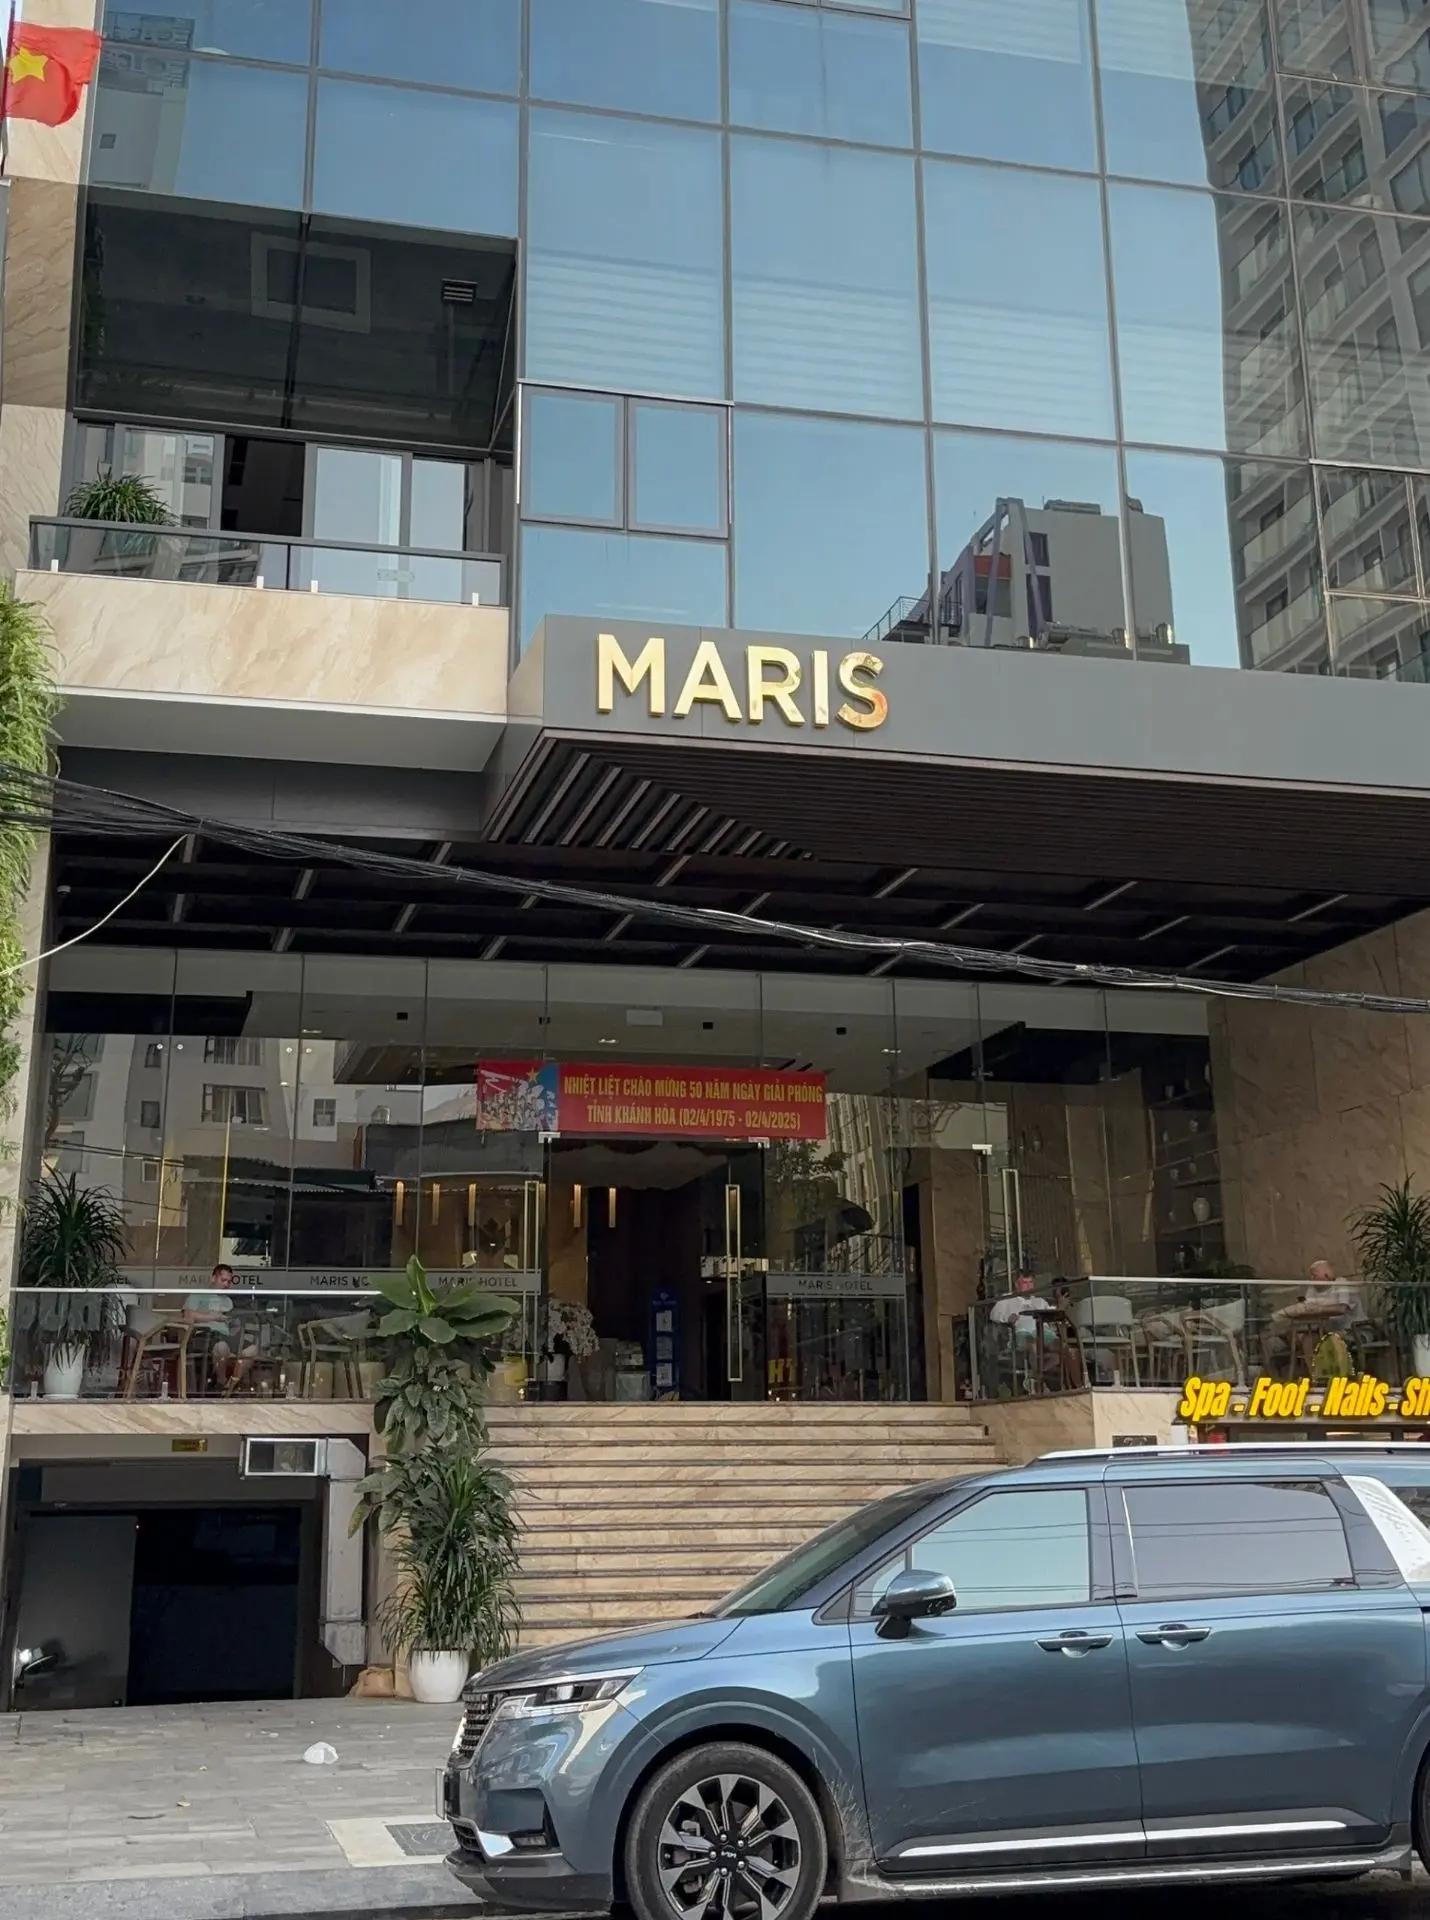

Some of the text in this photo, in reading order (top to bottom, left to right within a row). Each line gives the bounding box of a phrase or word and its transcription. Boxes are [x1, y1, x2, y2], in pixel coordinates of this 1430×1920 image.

[597, 633, 888, 731] MARIS
[564, 1076, 596, 1099] NHIỆT
[598, 1075, 620, 1100] LIỆT
[623, 1077, 652, 1097] CHÀO
[655, 1078, 686, 1098] MỪNG
[689, 1080, 702, 1097] 50
[705, 1079, 730, 1099] NĂM
[733, 1079, 760, 1101] NGÀY
[764, 1078, 784, 1102] GIẢI
[587, 1100, 611, 1123] TỈNH
[615, 1103, 652, 1124] KHÁNH
[679, 1108, 735, 1128] (02/4/1975
[745, 1111, 800, 1130] 02/4/2025)
[178, 1275, 263, 1286] MAR OTEL
[310, 1276, 348, 1286] MARIS
[479, 1277, 517, 1287] HOTEL
[1180, 1376, 1231, 1422] Spa
[1249, 1377, 1310, 1417] Foot
[1323, 1375, 1389, 1416] Nails
